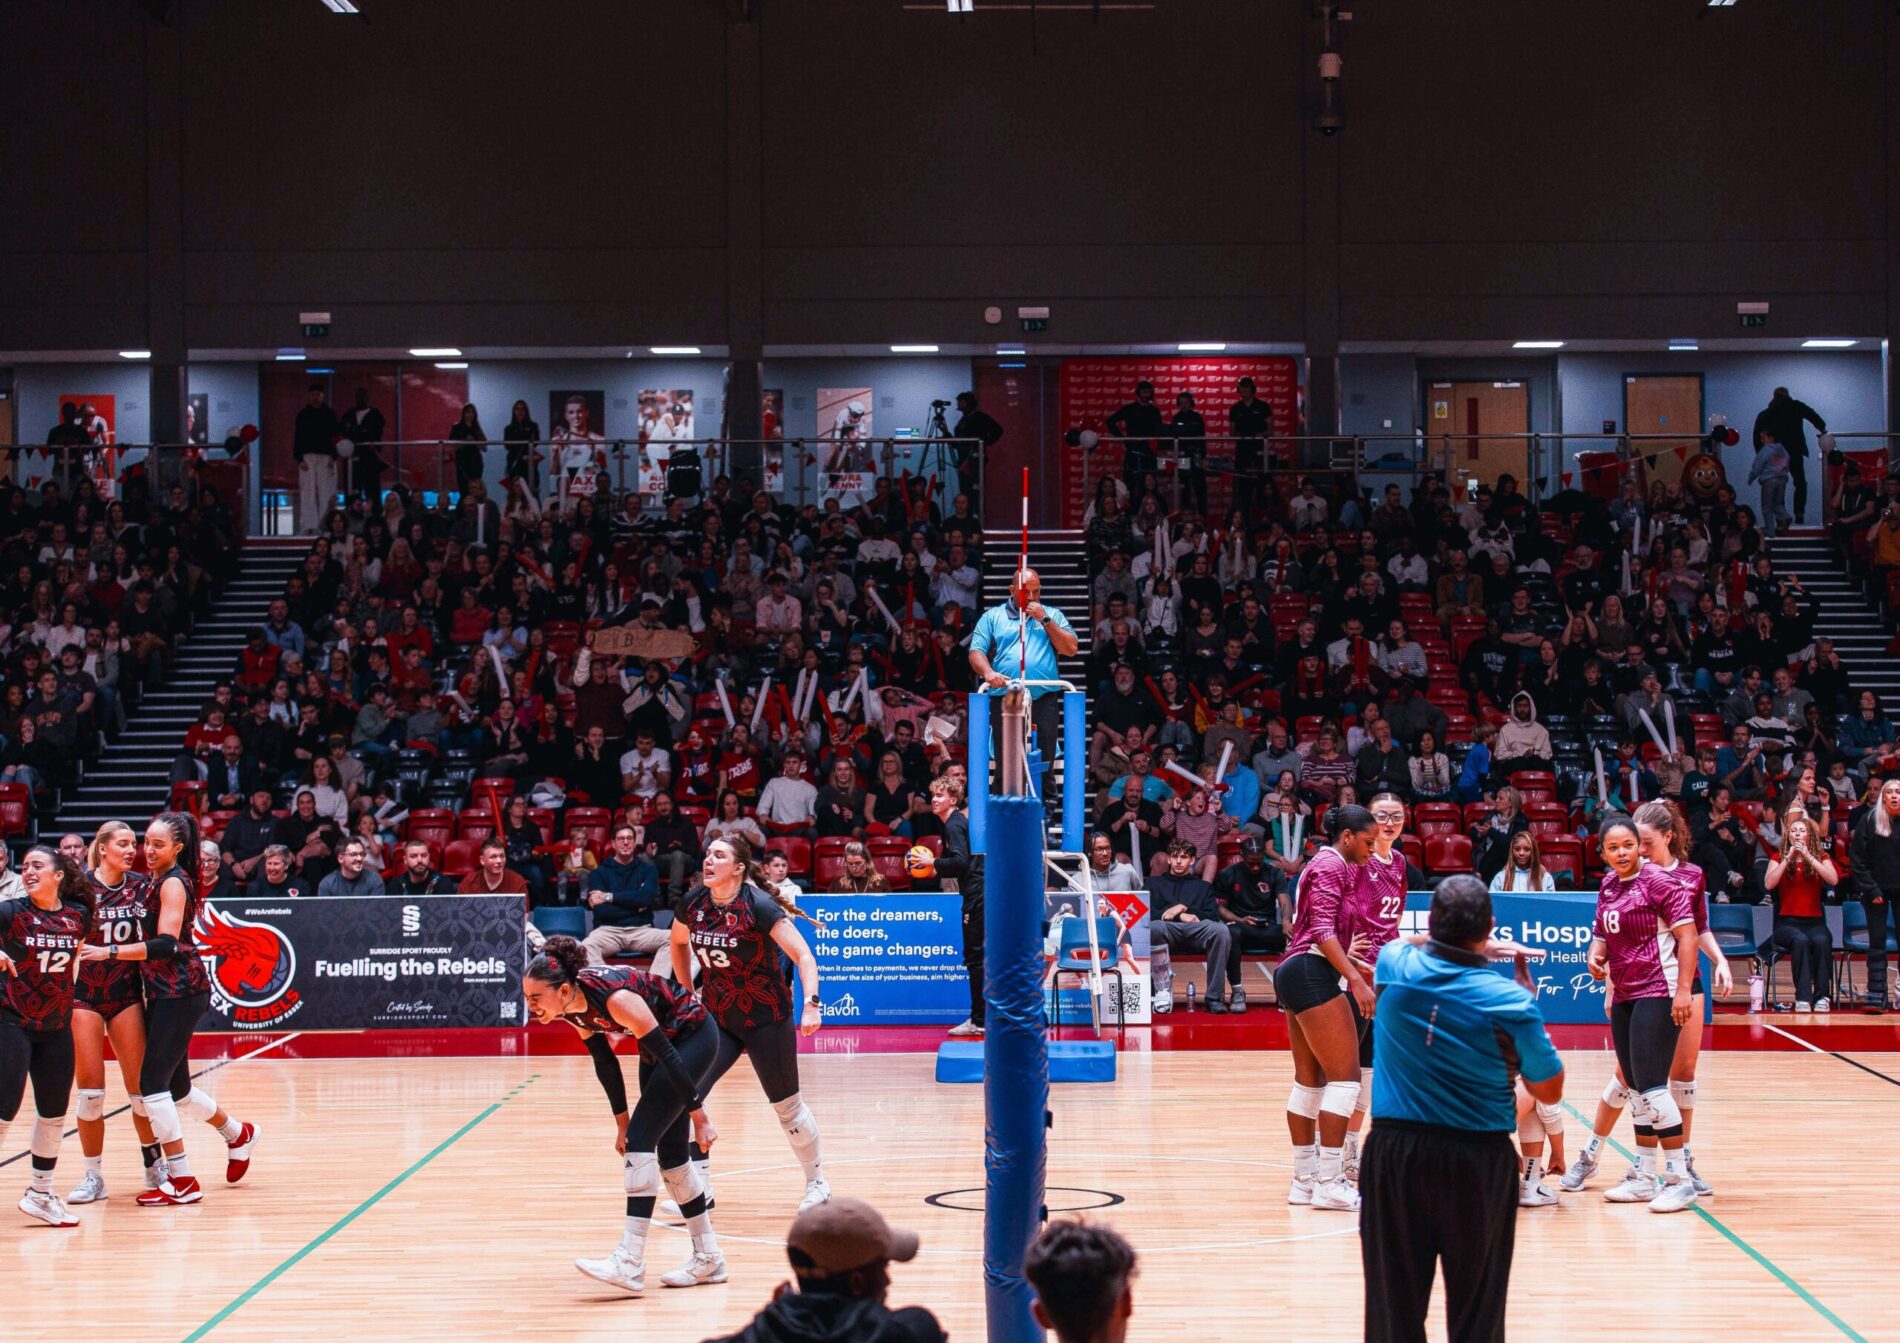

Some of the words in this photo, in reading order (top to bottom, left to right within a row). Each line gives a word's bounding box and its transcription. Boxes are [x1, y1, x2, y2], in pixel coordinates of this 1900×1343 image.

[98, 908, 135, 919] EBEL
[244, 908, 292, 916] #WeAreRebels
[1379, 896, 1401, 919] 22
[816, 908, 840, 922] For
[842, 908, 866, 922] the
[869, 908, 944, 924] dreamers,
[1602, 910, 1620, 934] 18
[99, 920, 132, 944] 10
[690, 932, 738, 948] REBELS
[815, 926, 840, 939] the
[844, 926, 889, 941] doers,
[25, 936, 79, 949] REBELS
[369, 947, 401, 955] SURRIDGE
[401, 947, 422, 955] SPORT
[422, 946, 453, 954] PROUDLY
[697, 948, 731, 968] 13
[815, 943, 839, 956] the
[842, 946, 883, 959] game
[887, 943, 958, 959] changers.
[1551, 951, 1589, 963] Healt
[36, 951, 71, 973] 12
[315, 957, 397, 982] Fuelling
[400, 958, 435, 976] the
[437, 957, 506, 975] Rebels
[873, 965, 908, 974] payments,
[940, 964, 955, 973] drop
[826, 974, 849, 982] matter
[875, 973, 884, 981] of
[884, 974, 900, 983] your
[900, 973, 930, 982] business,
[944, 972, 966, 983] higher
[1536, 975, 1564, 1001] For
[234, 988, 300, 1023] REBELS
[818, 1003, 860, 1017] Elavon
[232, 1019, 273, 1030] UNIVERSITY
[283, 999, 305, 1019] ESSEX
